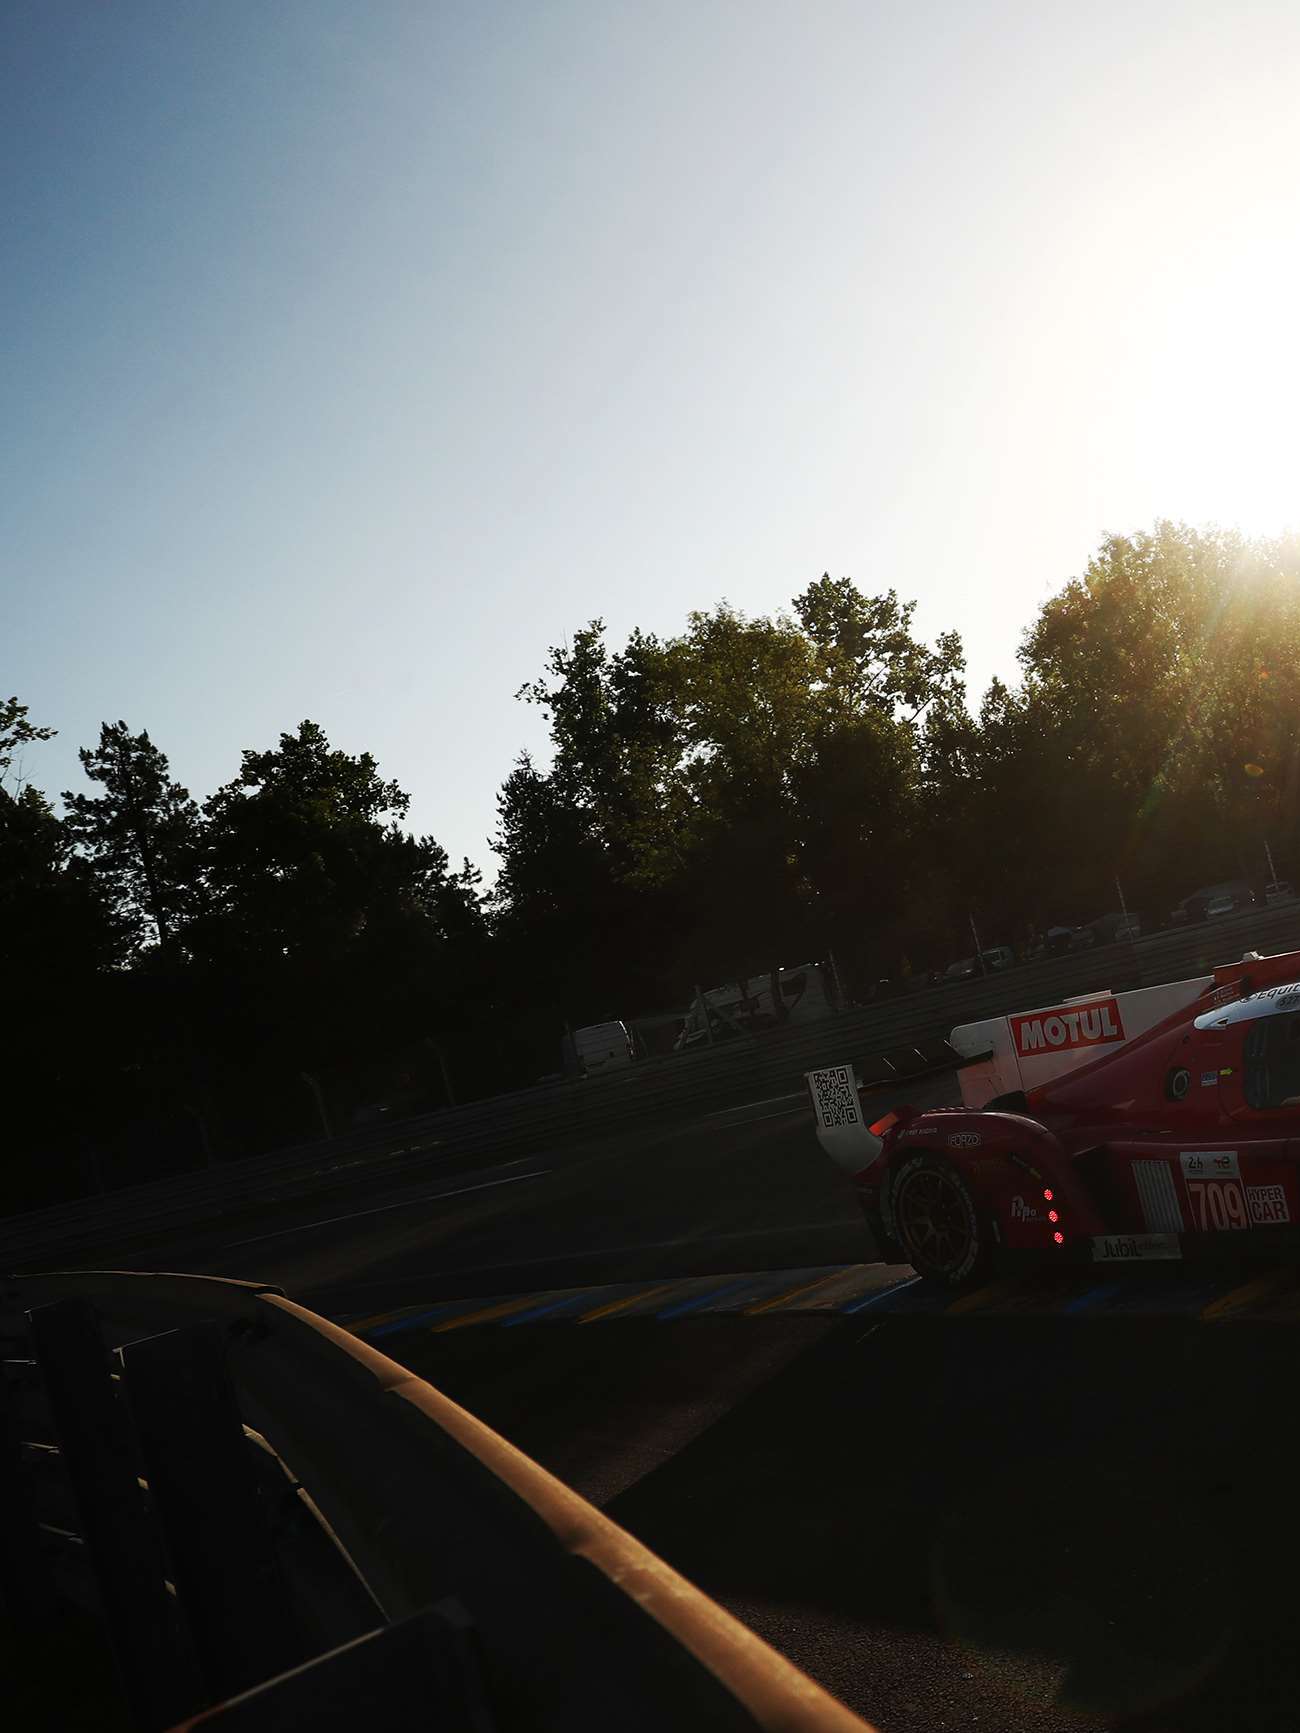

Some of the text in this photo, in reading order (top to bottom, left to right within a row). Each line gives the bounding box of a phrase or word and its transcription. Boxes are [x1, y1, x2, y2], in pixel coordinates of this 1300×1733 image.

[1020, 1007, 1118, 1051] MOTUL
[1188, 1182, 1249, 1232] 709
[1247, 1186, 1284, 1201] HYPER
[1251, 1201, 1287, 1222] CAR
